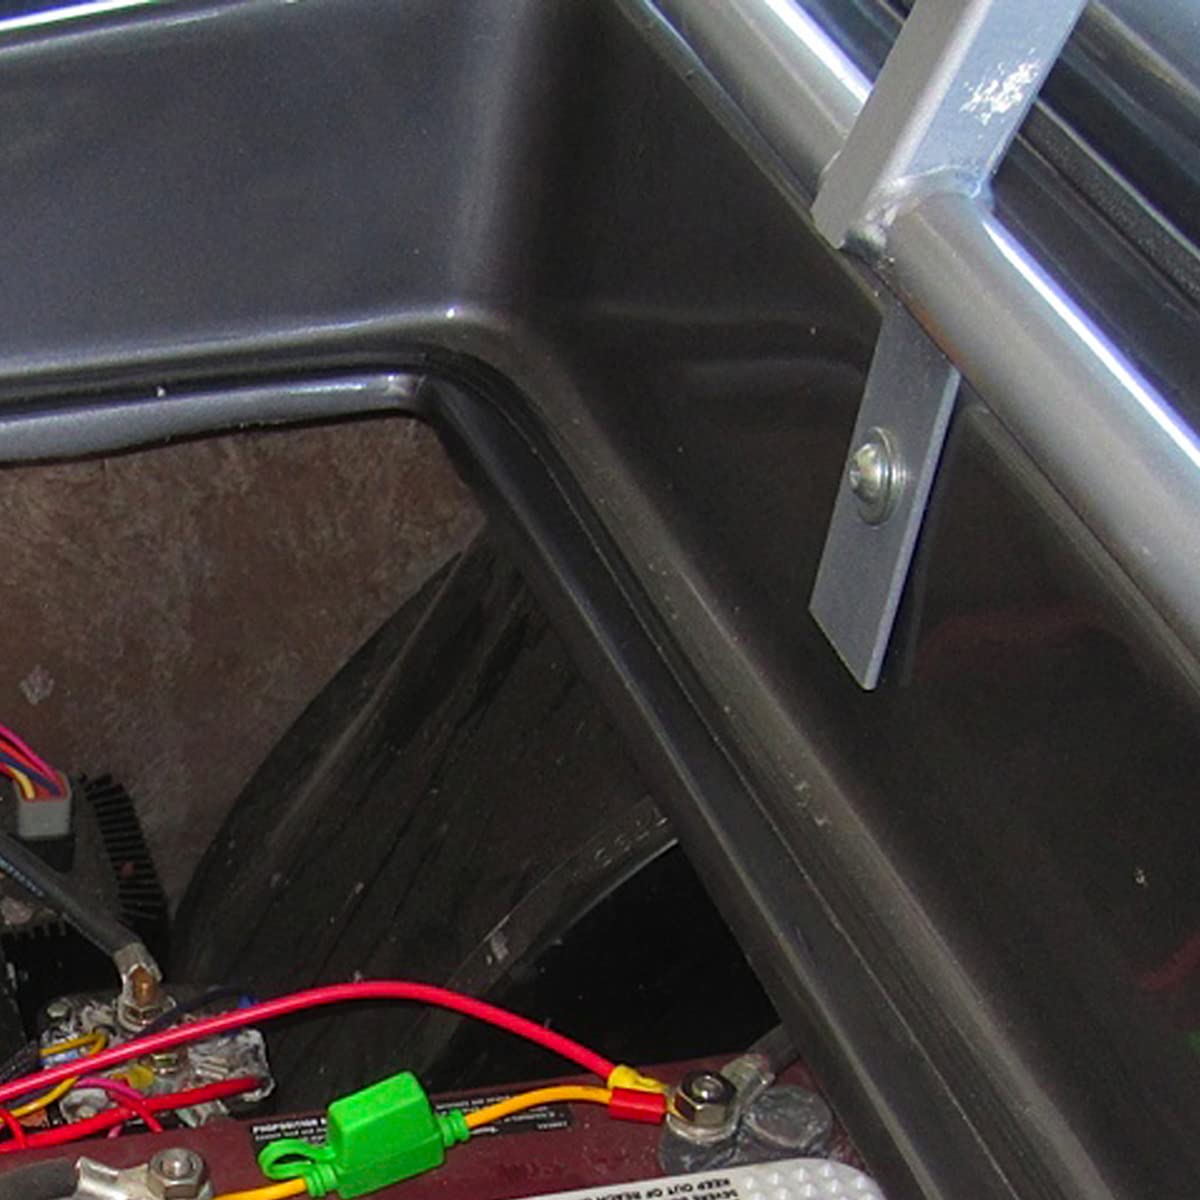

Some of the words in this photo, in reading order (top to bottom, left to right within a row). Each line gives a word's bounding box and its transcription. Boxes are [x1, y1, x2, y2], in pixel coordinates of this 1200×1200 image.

[667, 1183, 694, 1196] OUT
[697, 1178, 731, 1190] KEEP
[644, 1187, 663, 1199] OF
